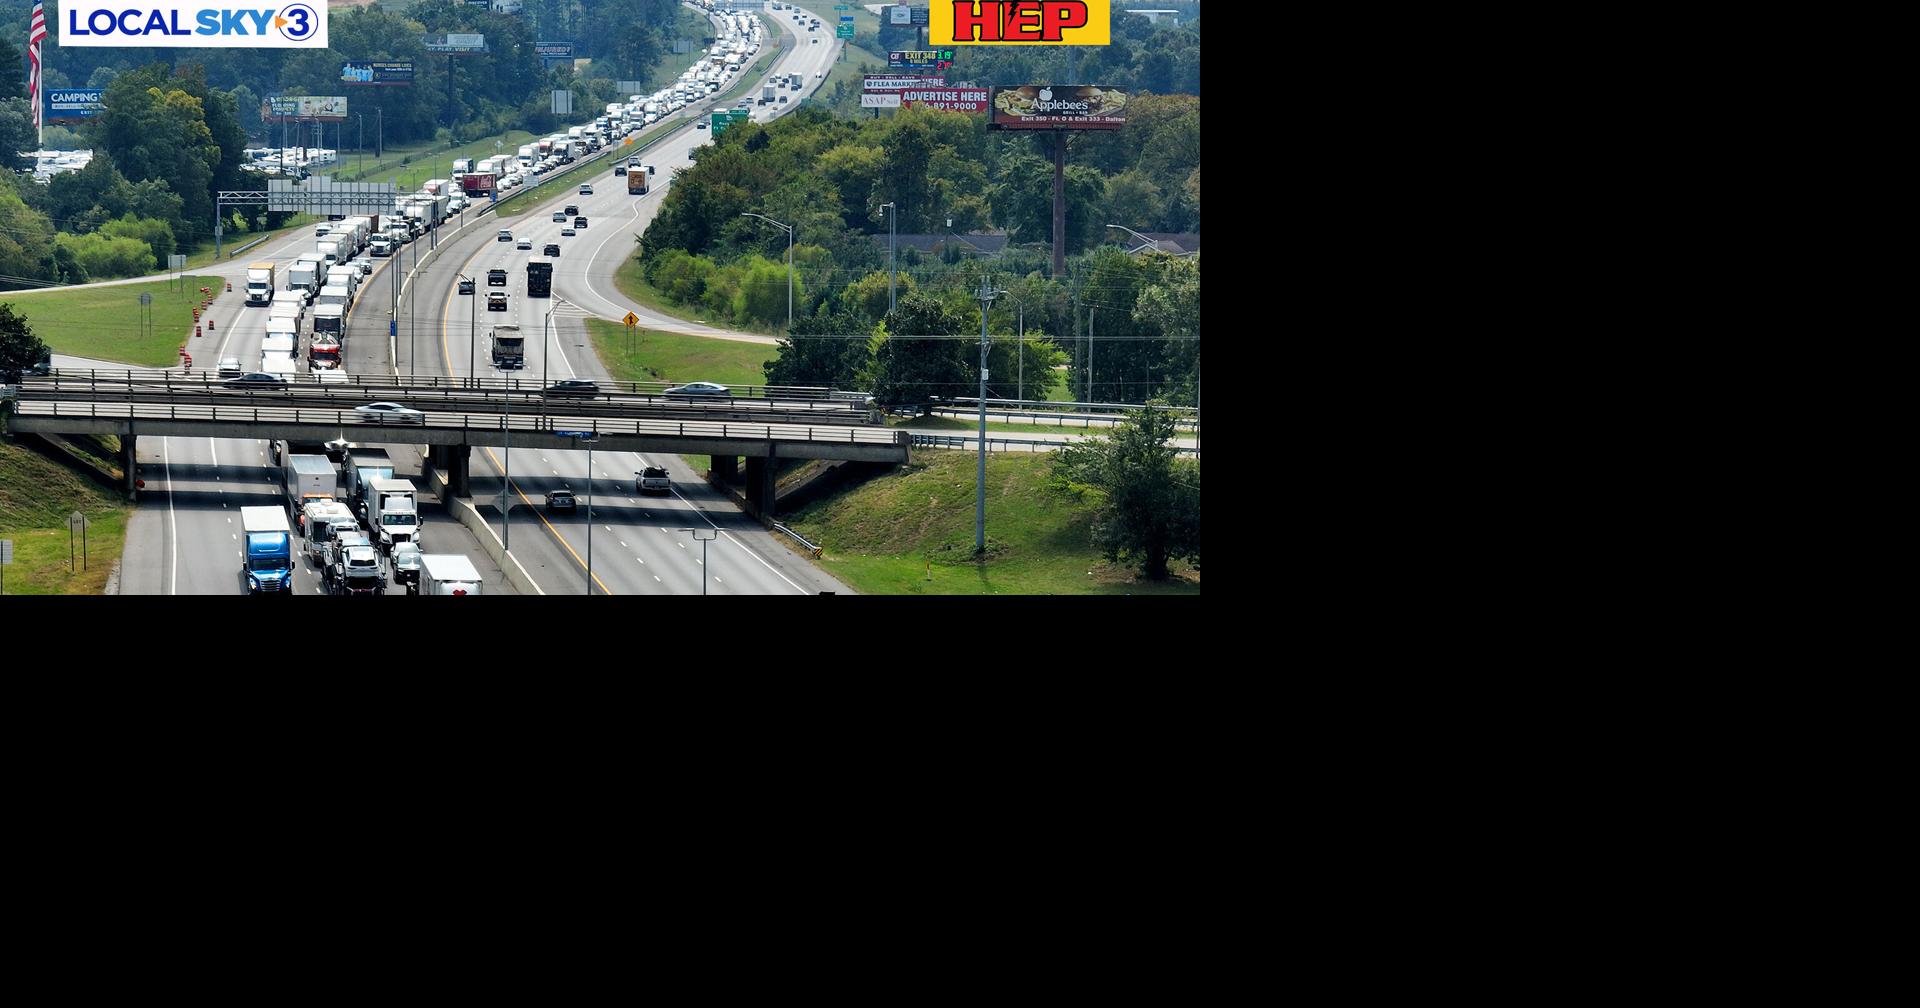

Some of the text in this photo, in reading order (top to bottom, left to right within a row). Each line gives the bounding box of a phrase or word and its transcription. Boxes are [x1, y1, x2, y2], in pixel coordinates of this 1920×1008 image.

[904, 52, 921, 60] EXIT
[51, 93, 98, 102] CAMPING
[863, 96, 886, 105] ASAP
[903, 91, 987, 102] ADVERTISE HERE
[1030, 97, 1088, 112] Applebee's
